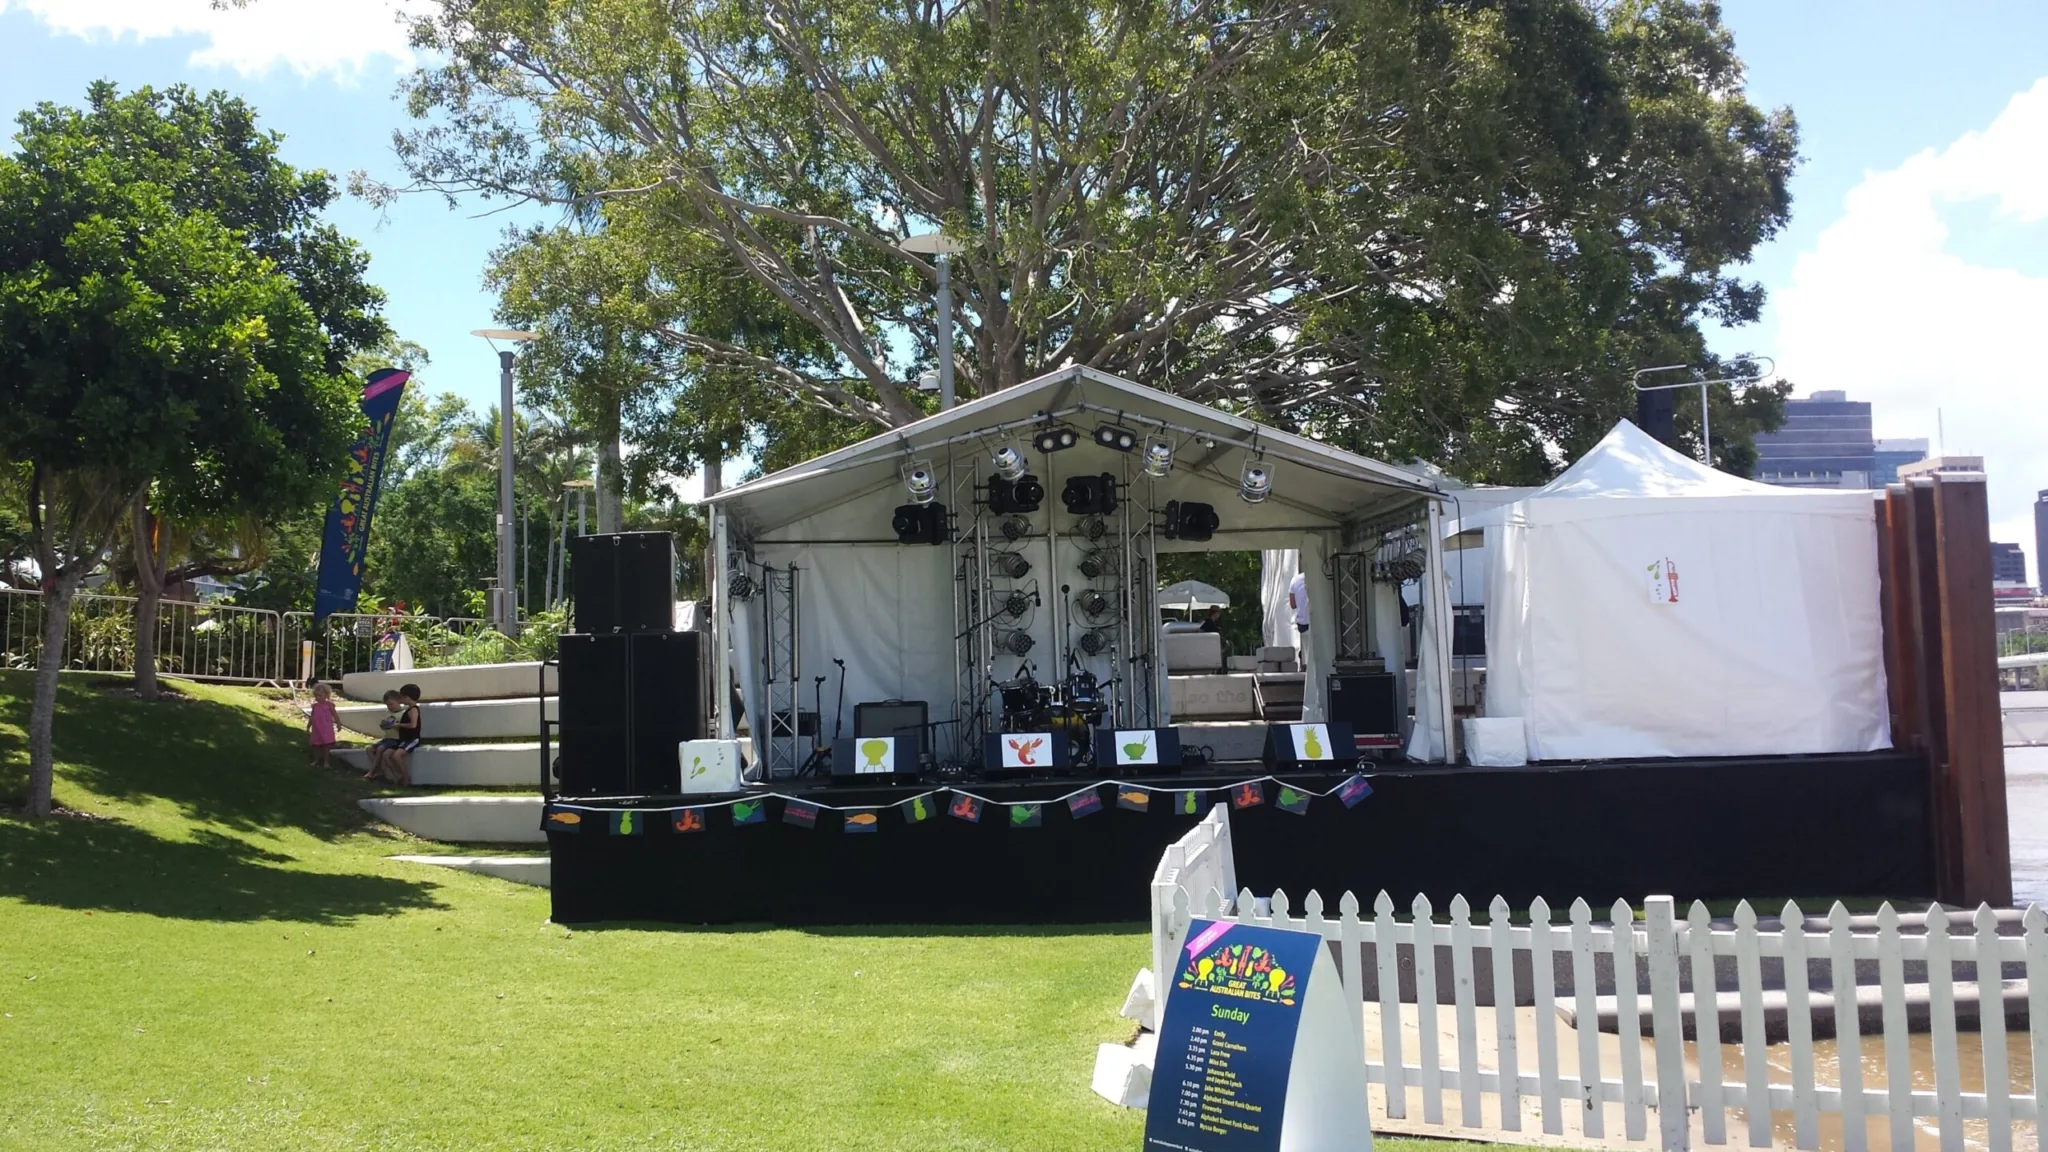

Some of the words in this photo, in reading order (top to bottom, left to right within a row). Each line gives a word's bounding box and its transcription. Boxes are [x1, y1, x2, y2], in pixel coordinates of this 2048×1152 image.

[362, 470, 376, 512] AUSTRALIAN
[371, 452, 380, 469] BITES
[1228, 980, 1247, 989] GREAT
[1209, 985, 1245, 998] AUSTRALIAN
[1244, 990, 1261, 1000] BITES
[1211, 1004, 1250, 1025] Sunday
[1214, 1030, 1226, 1039] Emily
[1212, 1039, 1224, 1047] Grant
[1202, 1103, 1222, 1114] Fireworks
[1203, 1094, 1222, 1104] Alphabet
[1222, 1098, 1235, 1107] Street
[1245, 1103, 1262, 1113] Quartet
[1201, 1113, 1220, 1123] Alphabet
[1219, 1117, 1233, 1126] Street
[1242, 1122, 1259, 1132] Quartet
